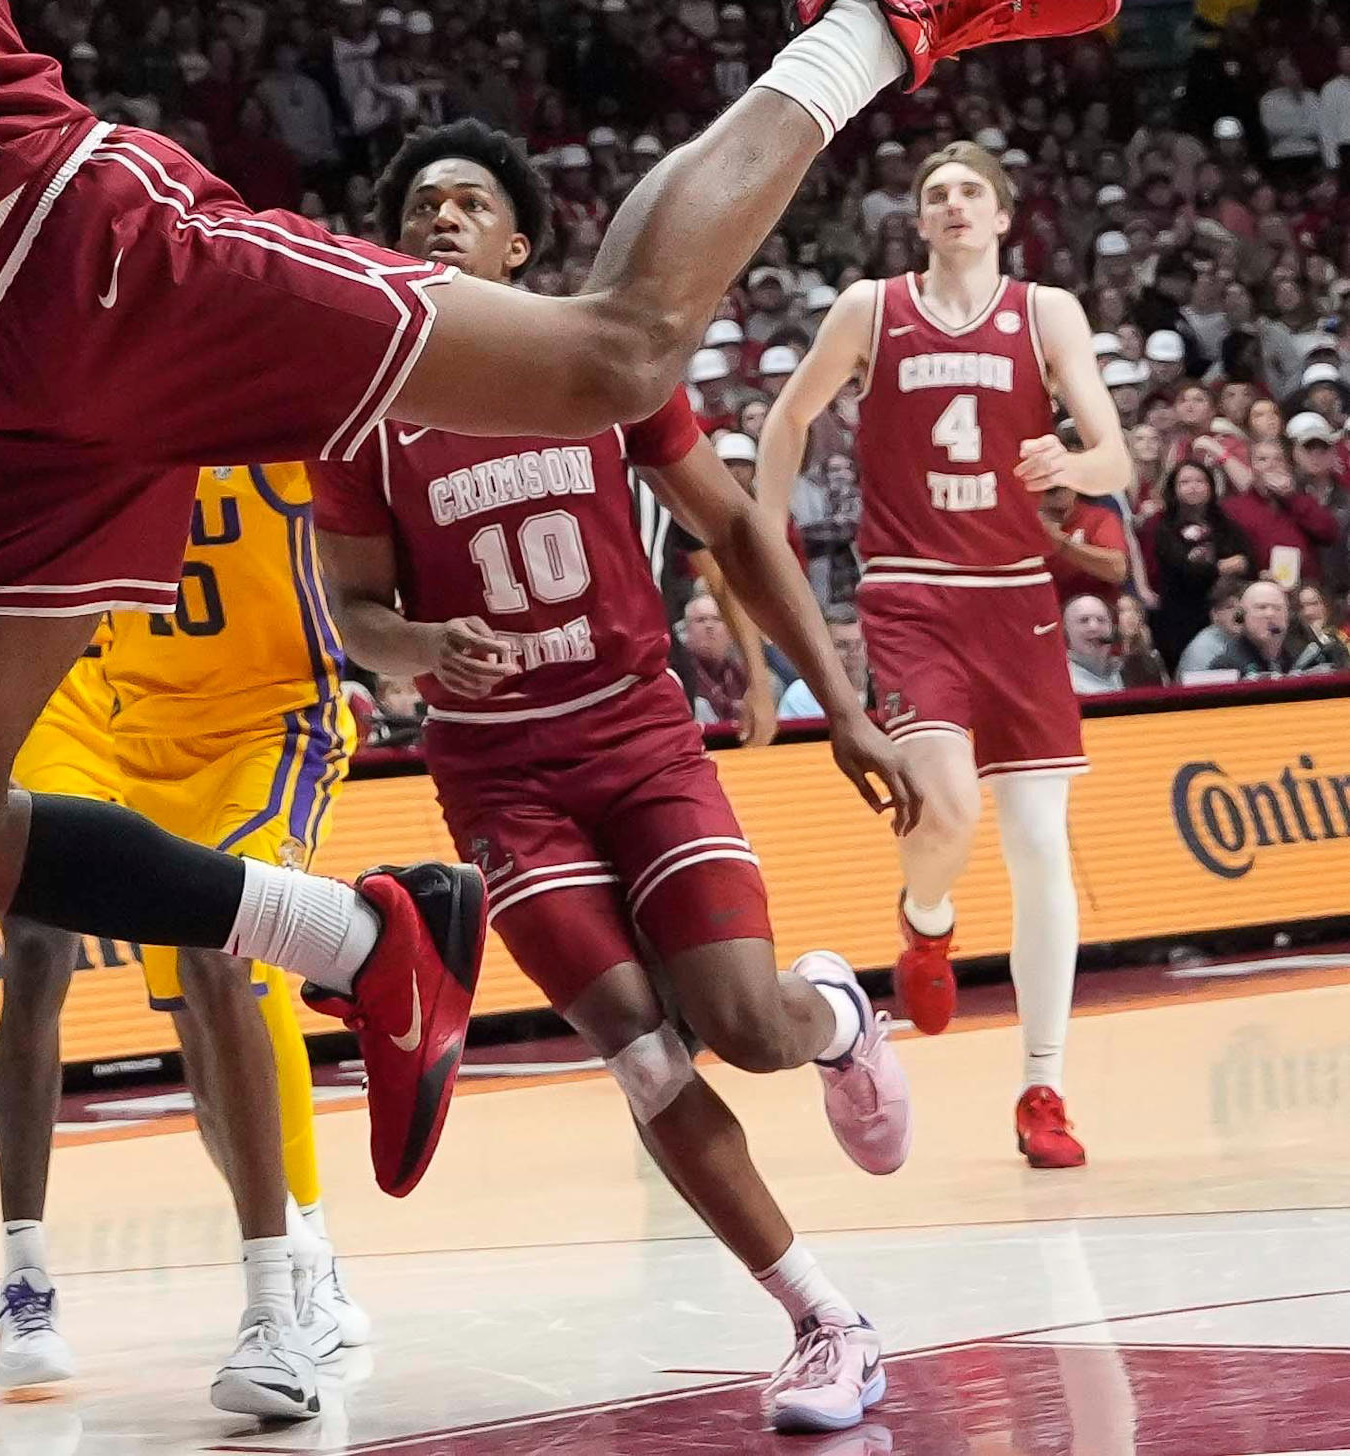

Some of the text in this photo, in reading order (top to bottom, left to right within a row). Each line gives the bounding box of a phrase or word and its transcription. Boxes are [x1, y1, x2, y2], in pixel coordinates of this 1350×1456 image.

[931, 394, 983, 463] 4
[428, 446, 597, 527] CRIMSON
[468, 508, 592, 615] 10
